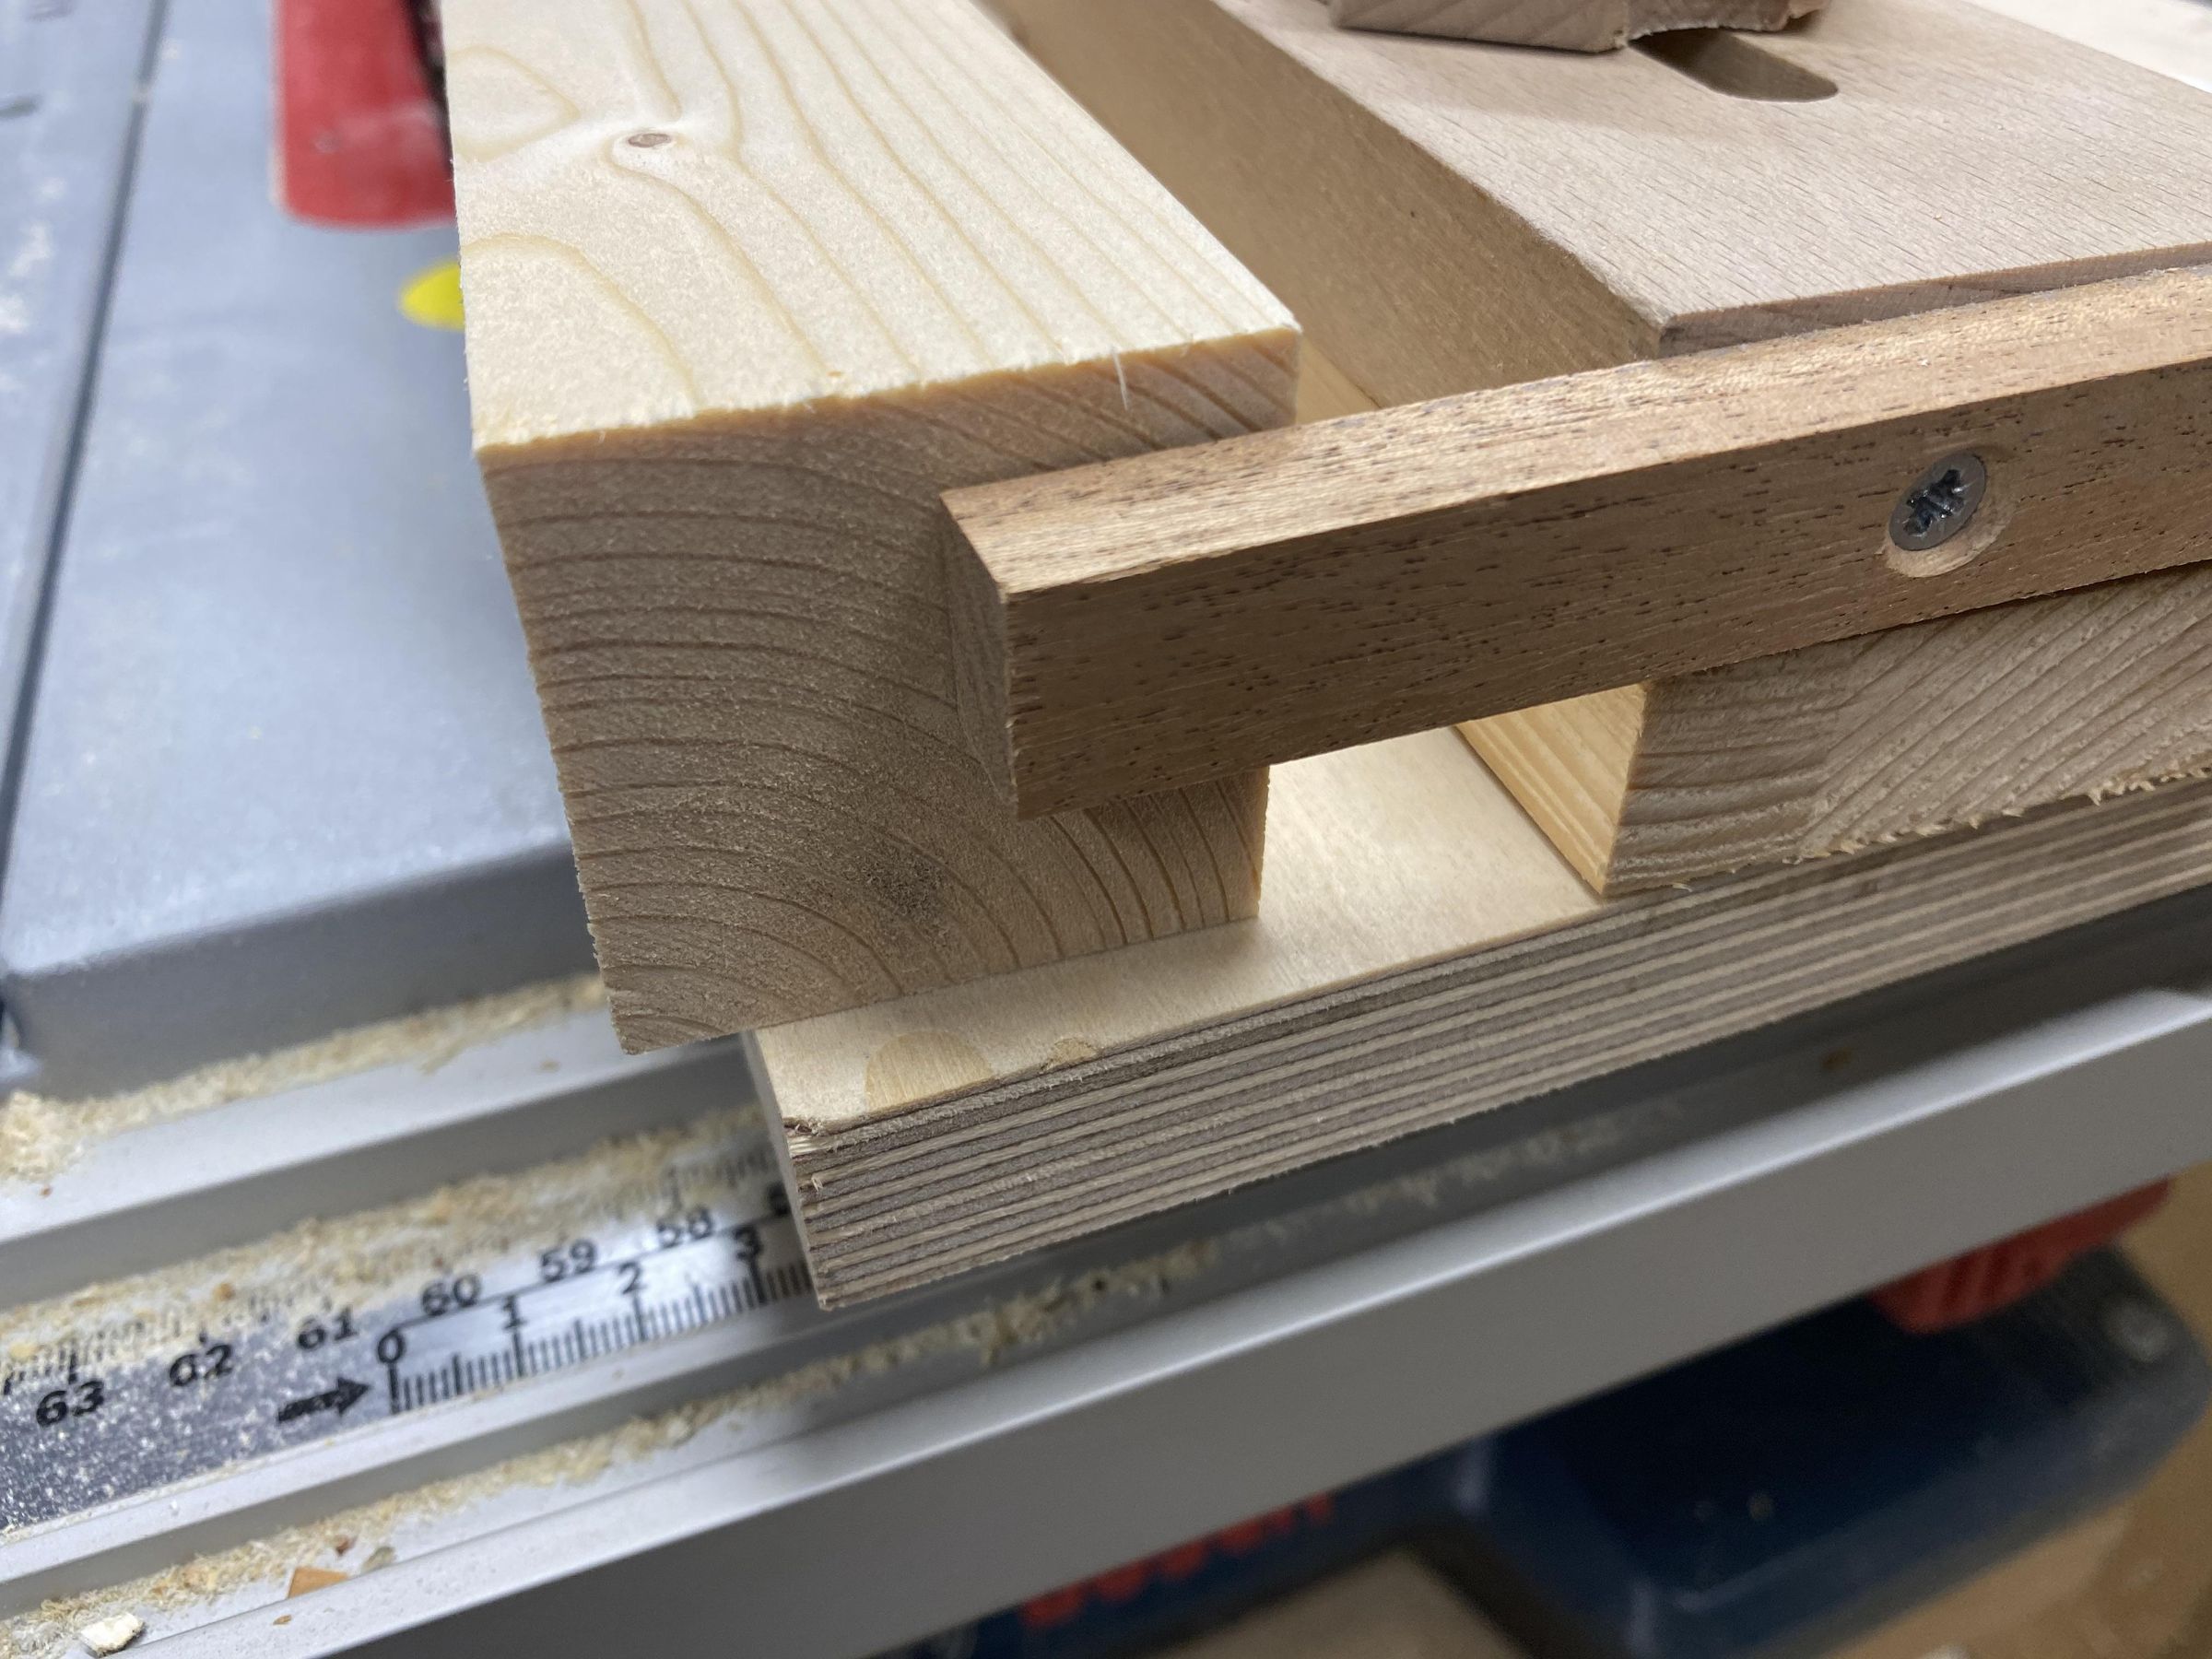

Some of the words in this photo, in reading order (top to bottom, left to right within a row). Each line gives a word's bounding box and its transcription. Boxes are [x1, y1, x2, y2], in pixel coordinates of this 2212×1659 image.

[36, 1380, 105, 1428] 63
[297, 1306, 359, 1350] 61
[421, 1273, 482, 1316] 60
[540, 1239, 598, 1282] 59
[377, 1328, 406, 1364] 0
[502, 1295, 526, 1329] 1
[617, 1263, 645, 1295] 2
[735, 1224, 763, 1261] 3
